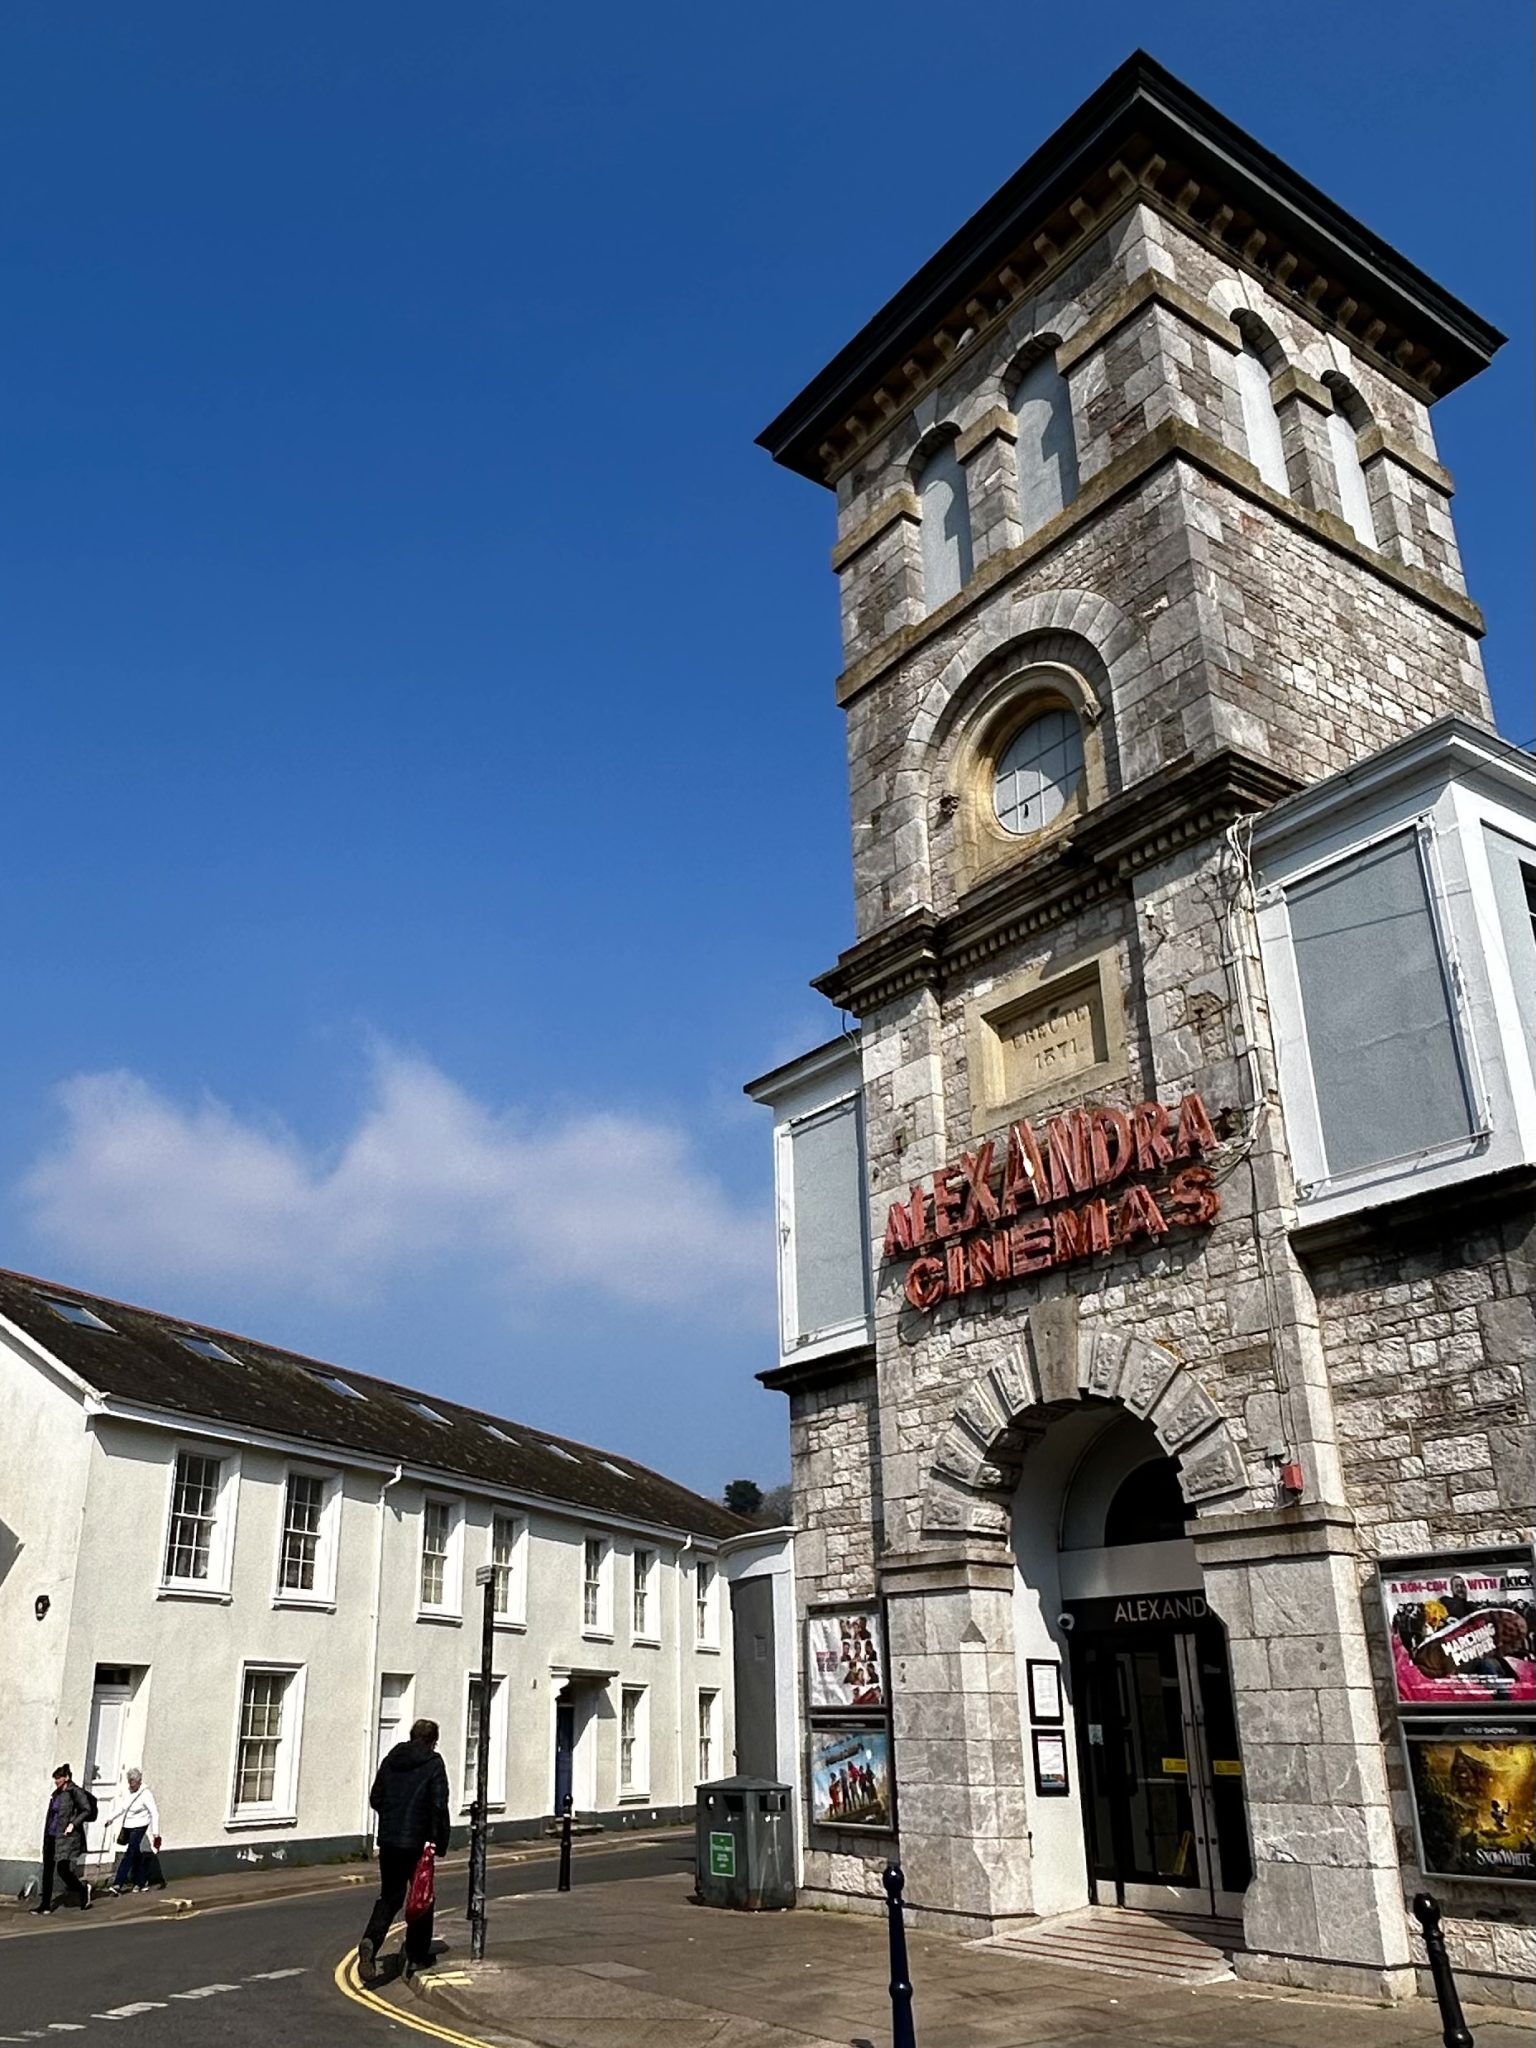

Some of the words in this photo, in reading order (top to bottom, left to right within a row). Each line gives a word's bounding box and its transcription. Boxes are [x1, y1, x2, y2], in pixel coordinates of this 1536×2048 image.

[884, 1093, 1218, 1257] ALEXANDRA
[904, 1166, 1221, 1312] CINEMAS
[1391, 1583, 1399, 1594] A
[1400, 1580, 1448, 1593] ROM-COM
[1466, 1578, 1498, 1590] WITH
[1507, 1575, 1534, 1586] KICK
[1114, 1596, 1213, 1623] ALEXAND
[1441, 1622, 1497, 1656] MARCHING
[1451, 1636, 1497, 1667] POWDER
